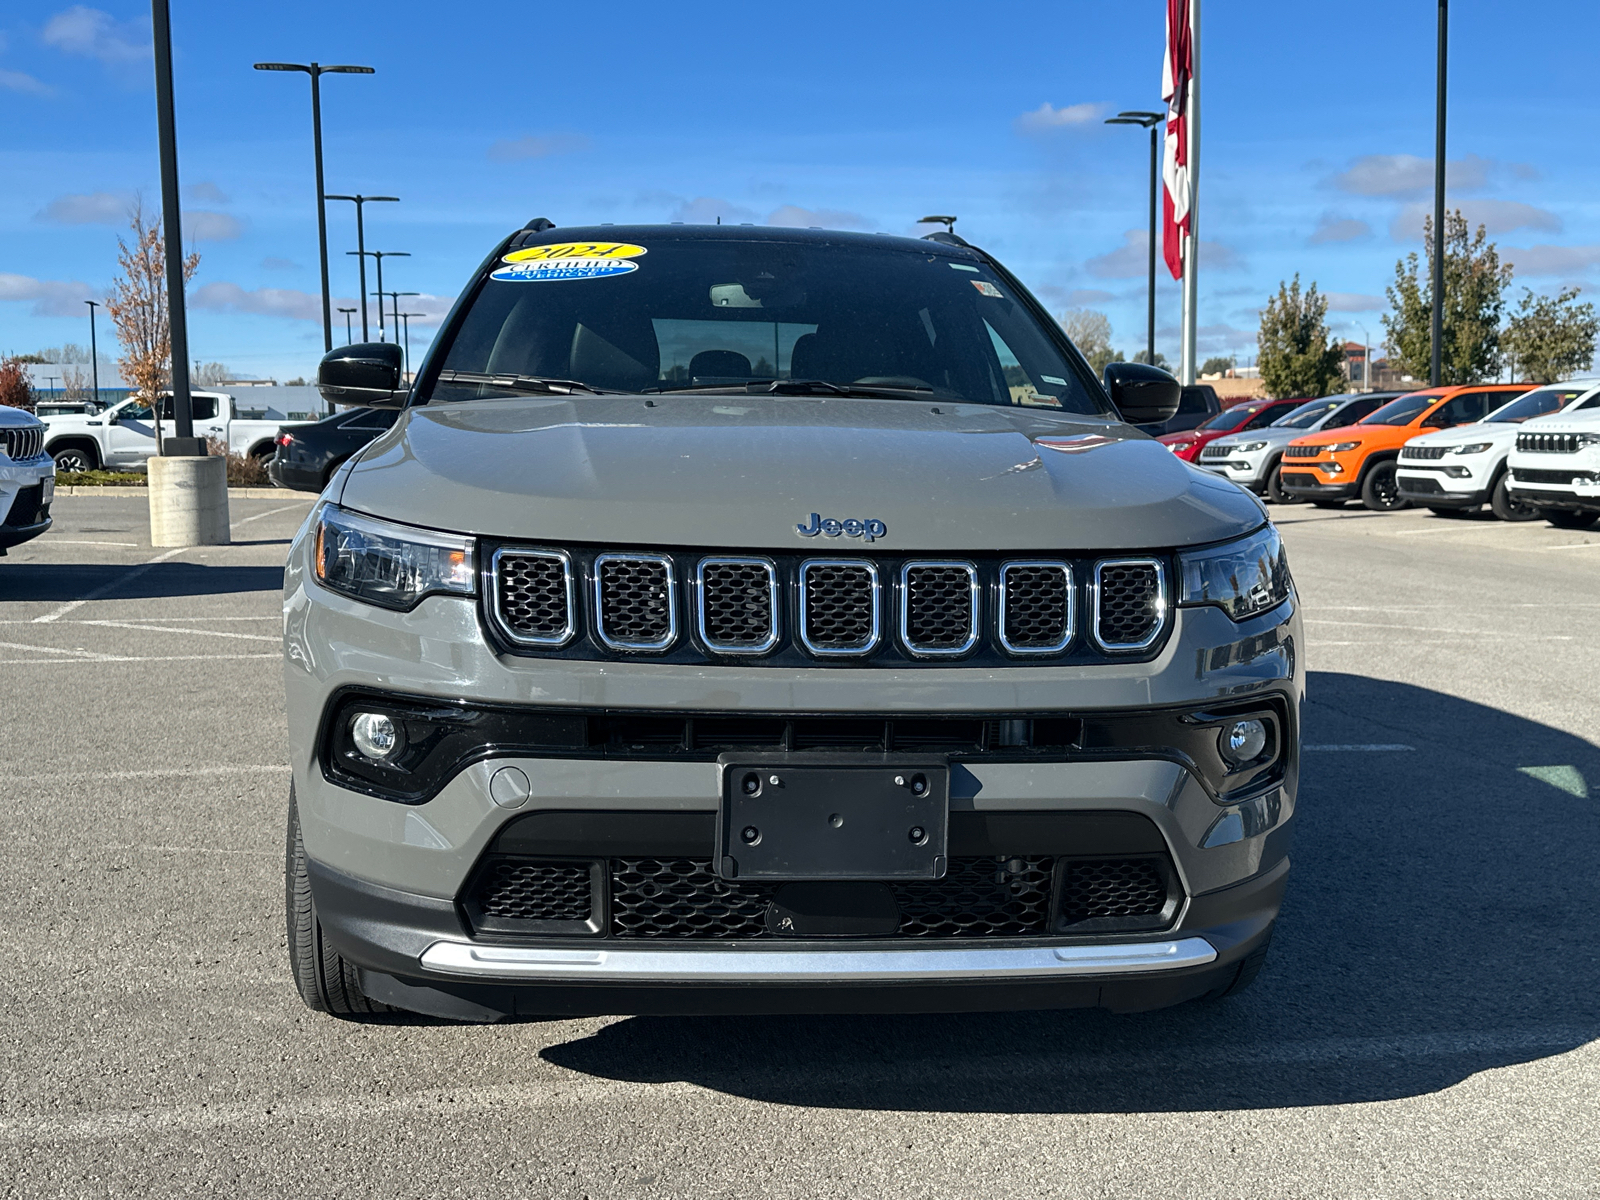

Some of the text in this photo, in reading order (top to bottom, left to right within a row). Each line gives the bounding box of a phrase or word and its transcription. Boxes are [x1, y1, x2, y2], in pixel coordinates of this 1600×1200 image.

[520, 245, 624, 261] 2024
[510, 260, 622, 271] CERTIFIED
[525, 270, 597, 279] VEHICLE
[796, 512, 887, 542] Jeep
